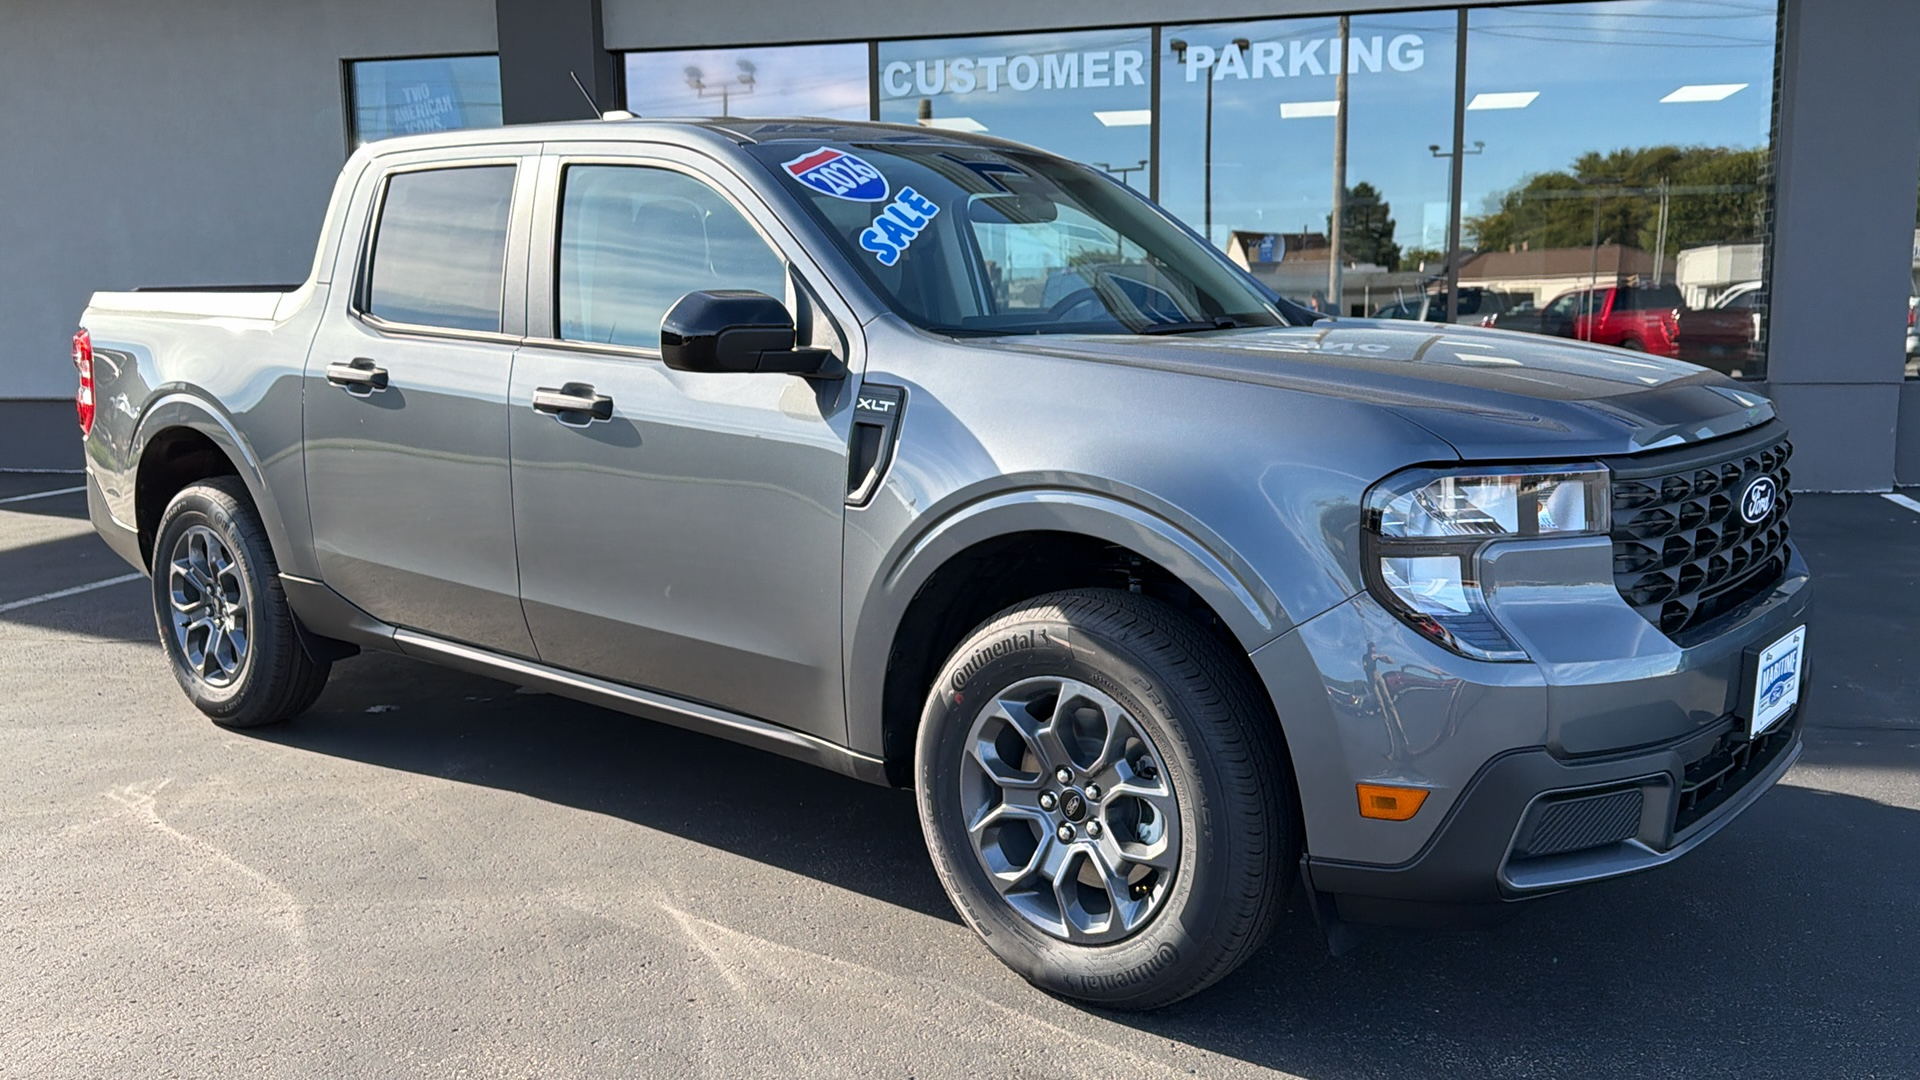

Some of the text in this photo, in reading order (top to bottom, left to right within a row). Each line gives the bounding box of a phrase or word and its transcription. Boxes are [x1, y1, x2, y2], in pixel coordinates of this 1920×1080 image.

[883, 34, 1424, 97] CUSTOMER PARKING
[395, 94, 453, 125] AMERICAN
[402, 83, 430, 104] TWO
[807, 157, 878, 195] 2026
[861, 187, 938, 264] SALE
[856, 398, 896, 412] XLT
[1748, 483, 1771, 517] Ford
[951, 629, 1035, 692] Continental
[1080, 942, 1180, 993] Continental
